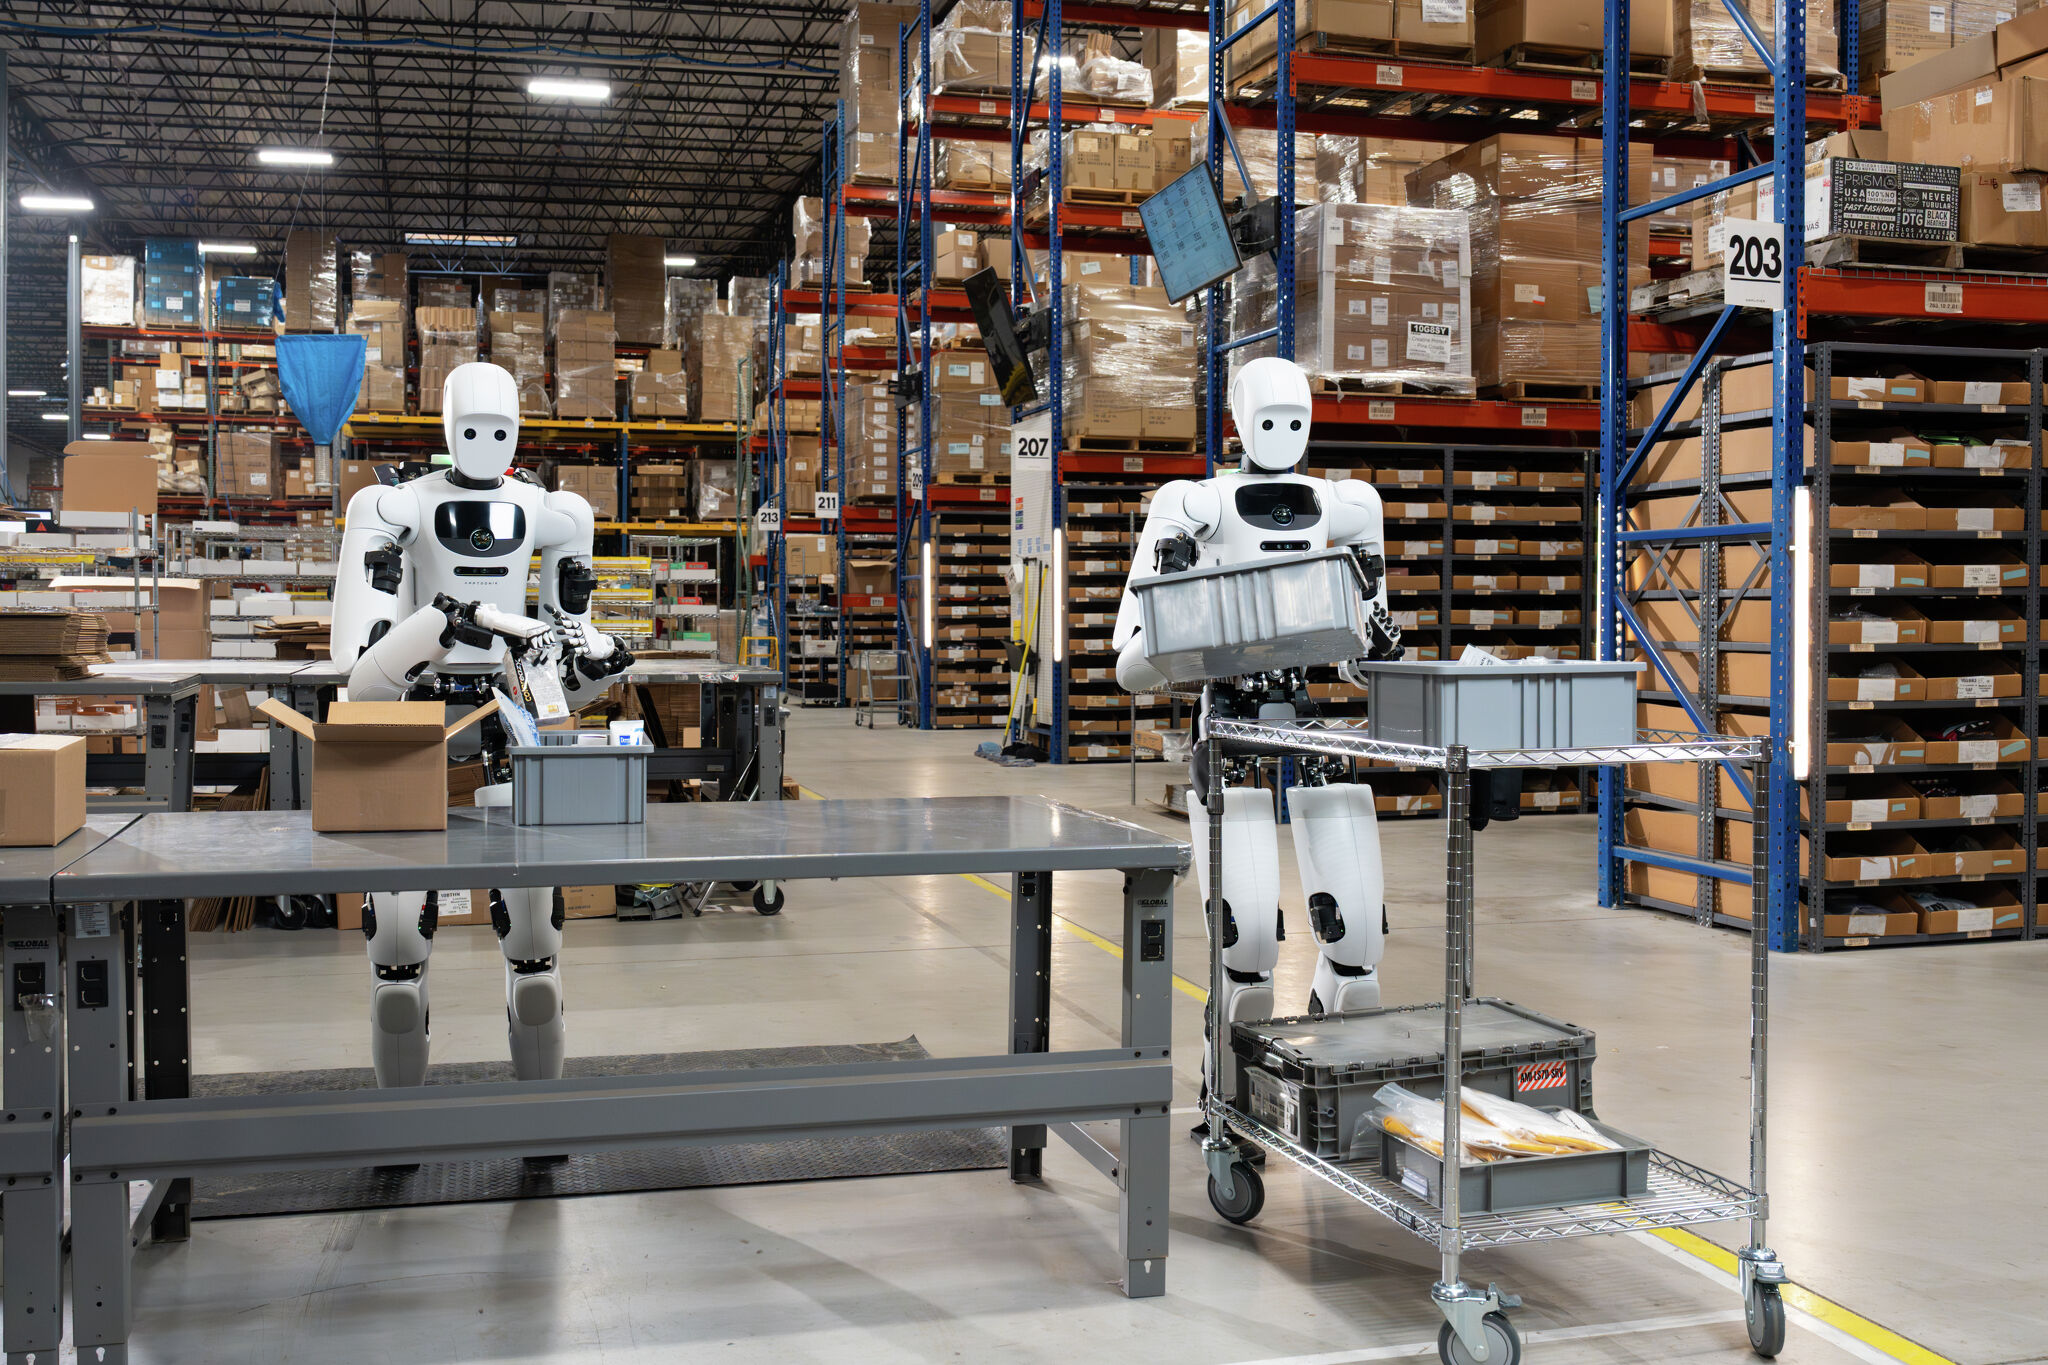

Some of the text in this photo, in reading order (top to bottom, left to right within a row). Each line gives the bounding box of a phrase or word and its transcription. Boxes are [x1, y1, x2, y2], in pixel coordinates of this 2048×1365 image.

[1844, 188, 1866, 197] USA
[1922, 192, 1951, 202] NEVER
[1844, 203, 1896, 213] FAST FASHION
[1922, 201, 1952, 209] TUBULAR
[1902, 212, 1924, 226] DTG
[1927, 210, 1948, 220] BLACK
[1844, 220, 1895, 232] SUPERIOR
[1900, 232, 1950, 240] CALIFORNIA
[1730, 234, 1782, 278] 203
[1018, 438, 1049, 456] 207
[912, 472, 922, 488] 209
[818, 496, 836, 509] 211
[760, 512, 778, 523] 213
